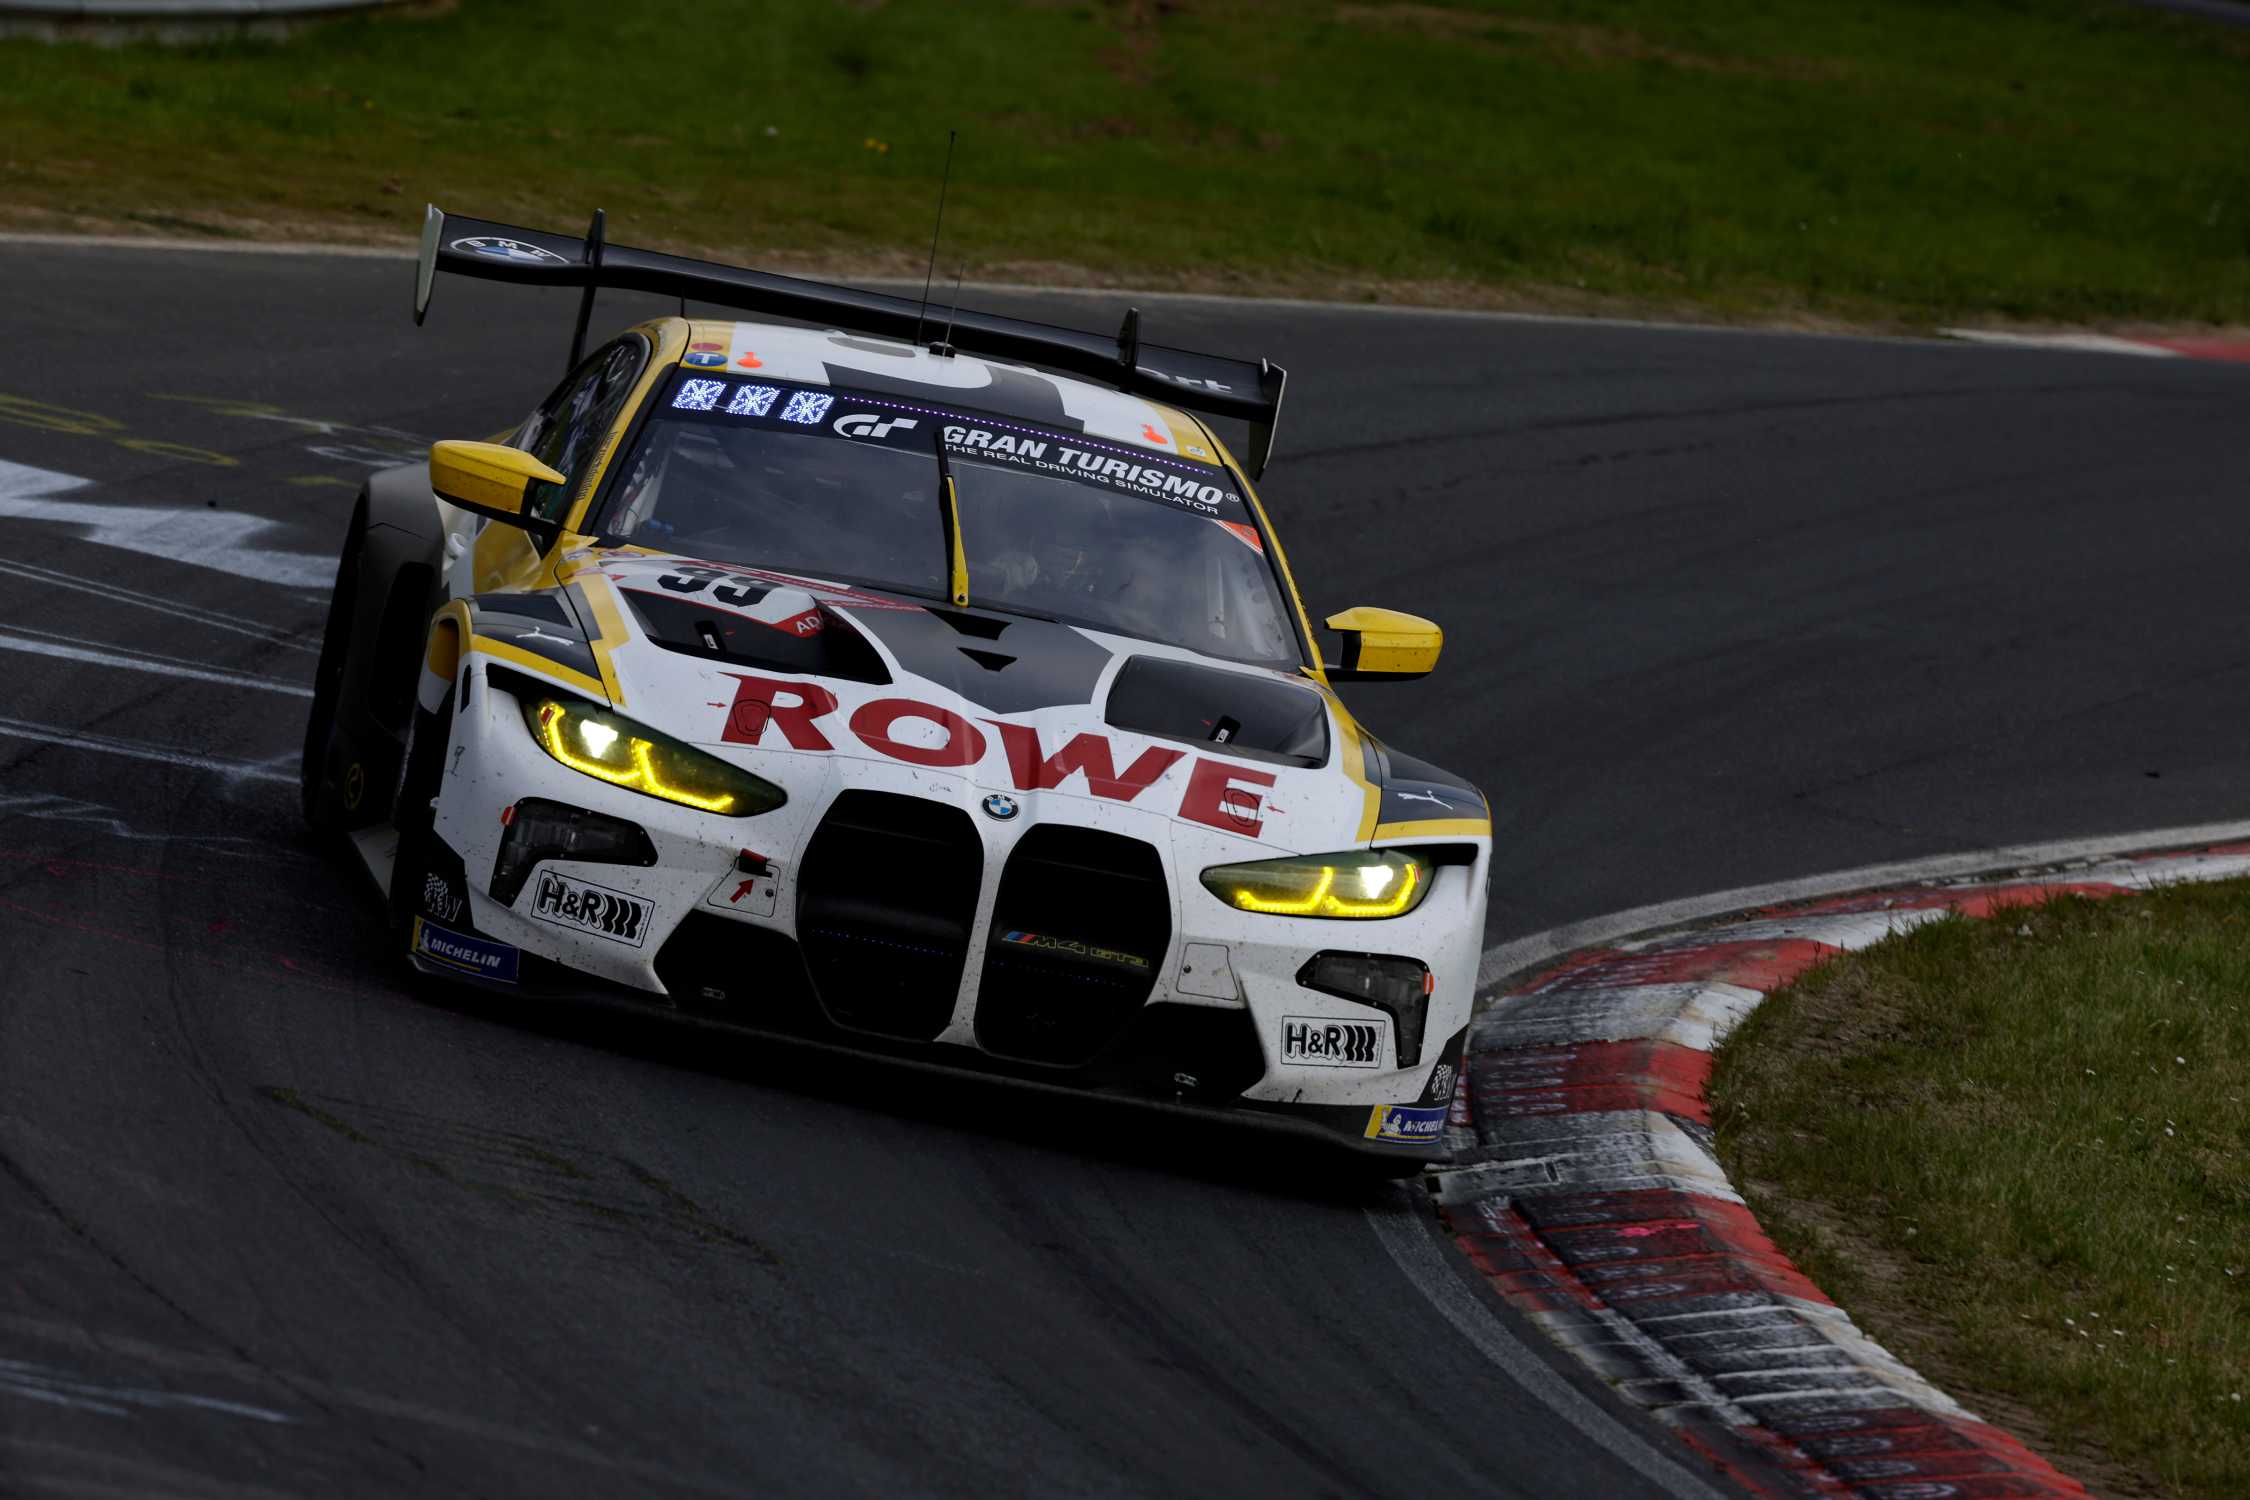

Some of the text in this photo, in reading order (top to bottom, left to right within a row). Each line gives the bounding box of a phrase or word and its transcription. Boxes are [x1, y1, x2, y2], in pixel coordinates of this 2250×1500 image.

[943, 425, 1048, 459] GRAN
[944, 444, 1219, 515] THE REAL DRIVING SIMULATOR
[717, 671, 1277, 837] ROWE
[537, 878, 606, 928] H&R
[430, 938, 501, 968] MICHELIN
[1285, 1022, 1345, 1060] H&R
